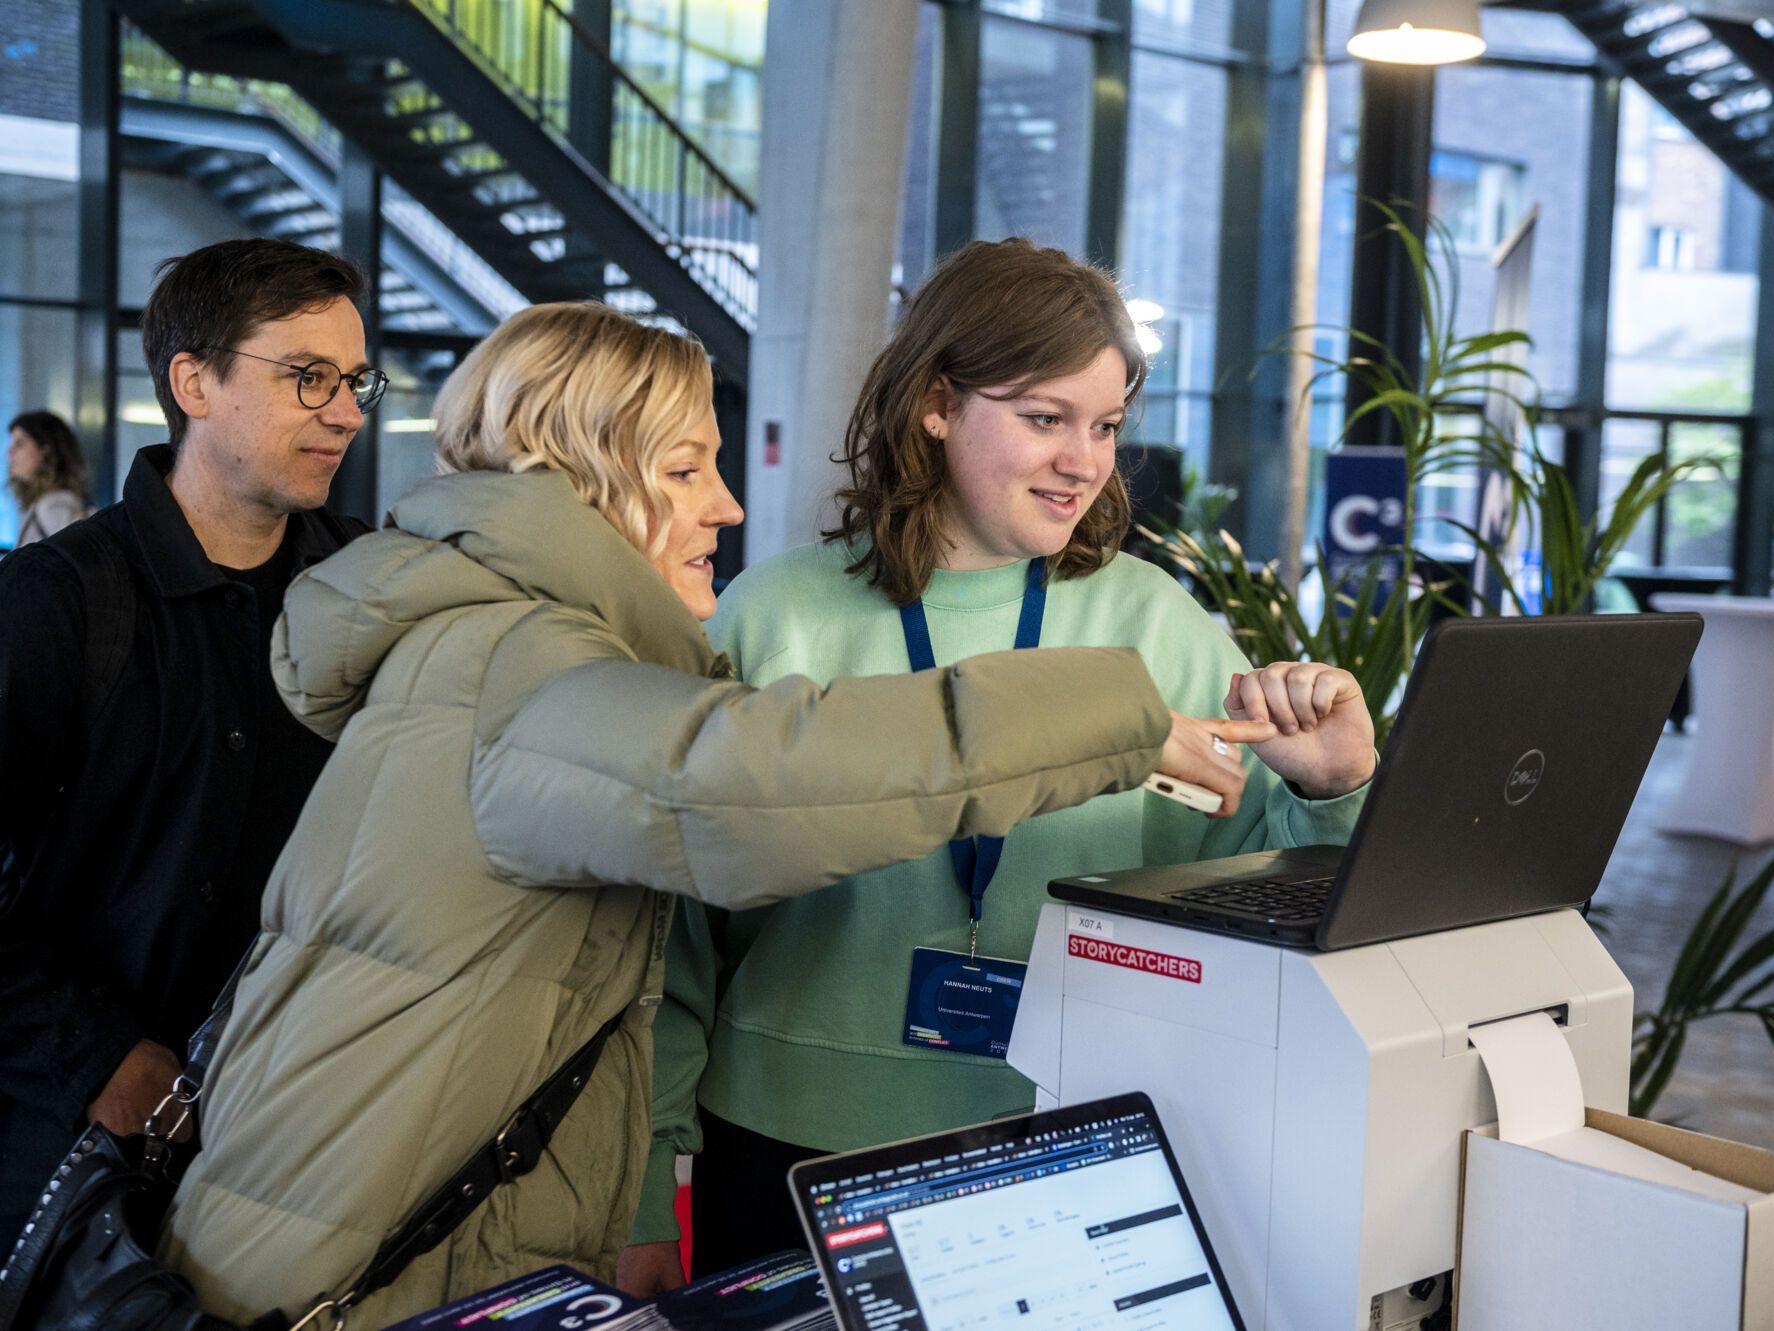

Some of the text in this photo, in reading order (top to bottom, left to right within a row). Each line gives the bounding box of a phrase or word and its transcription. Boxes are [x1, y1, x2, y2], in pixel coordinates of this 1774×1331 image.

[1079, 916, 1103, 931] X07 A
[1070, 938, 1200, 980] STORYCATCHERS
[943, 980, 993, 993] HANNAH NEUTS
